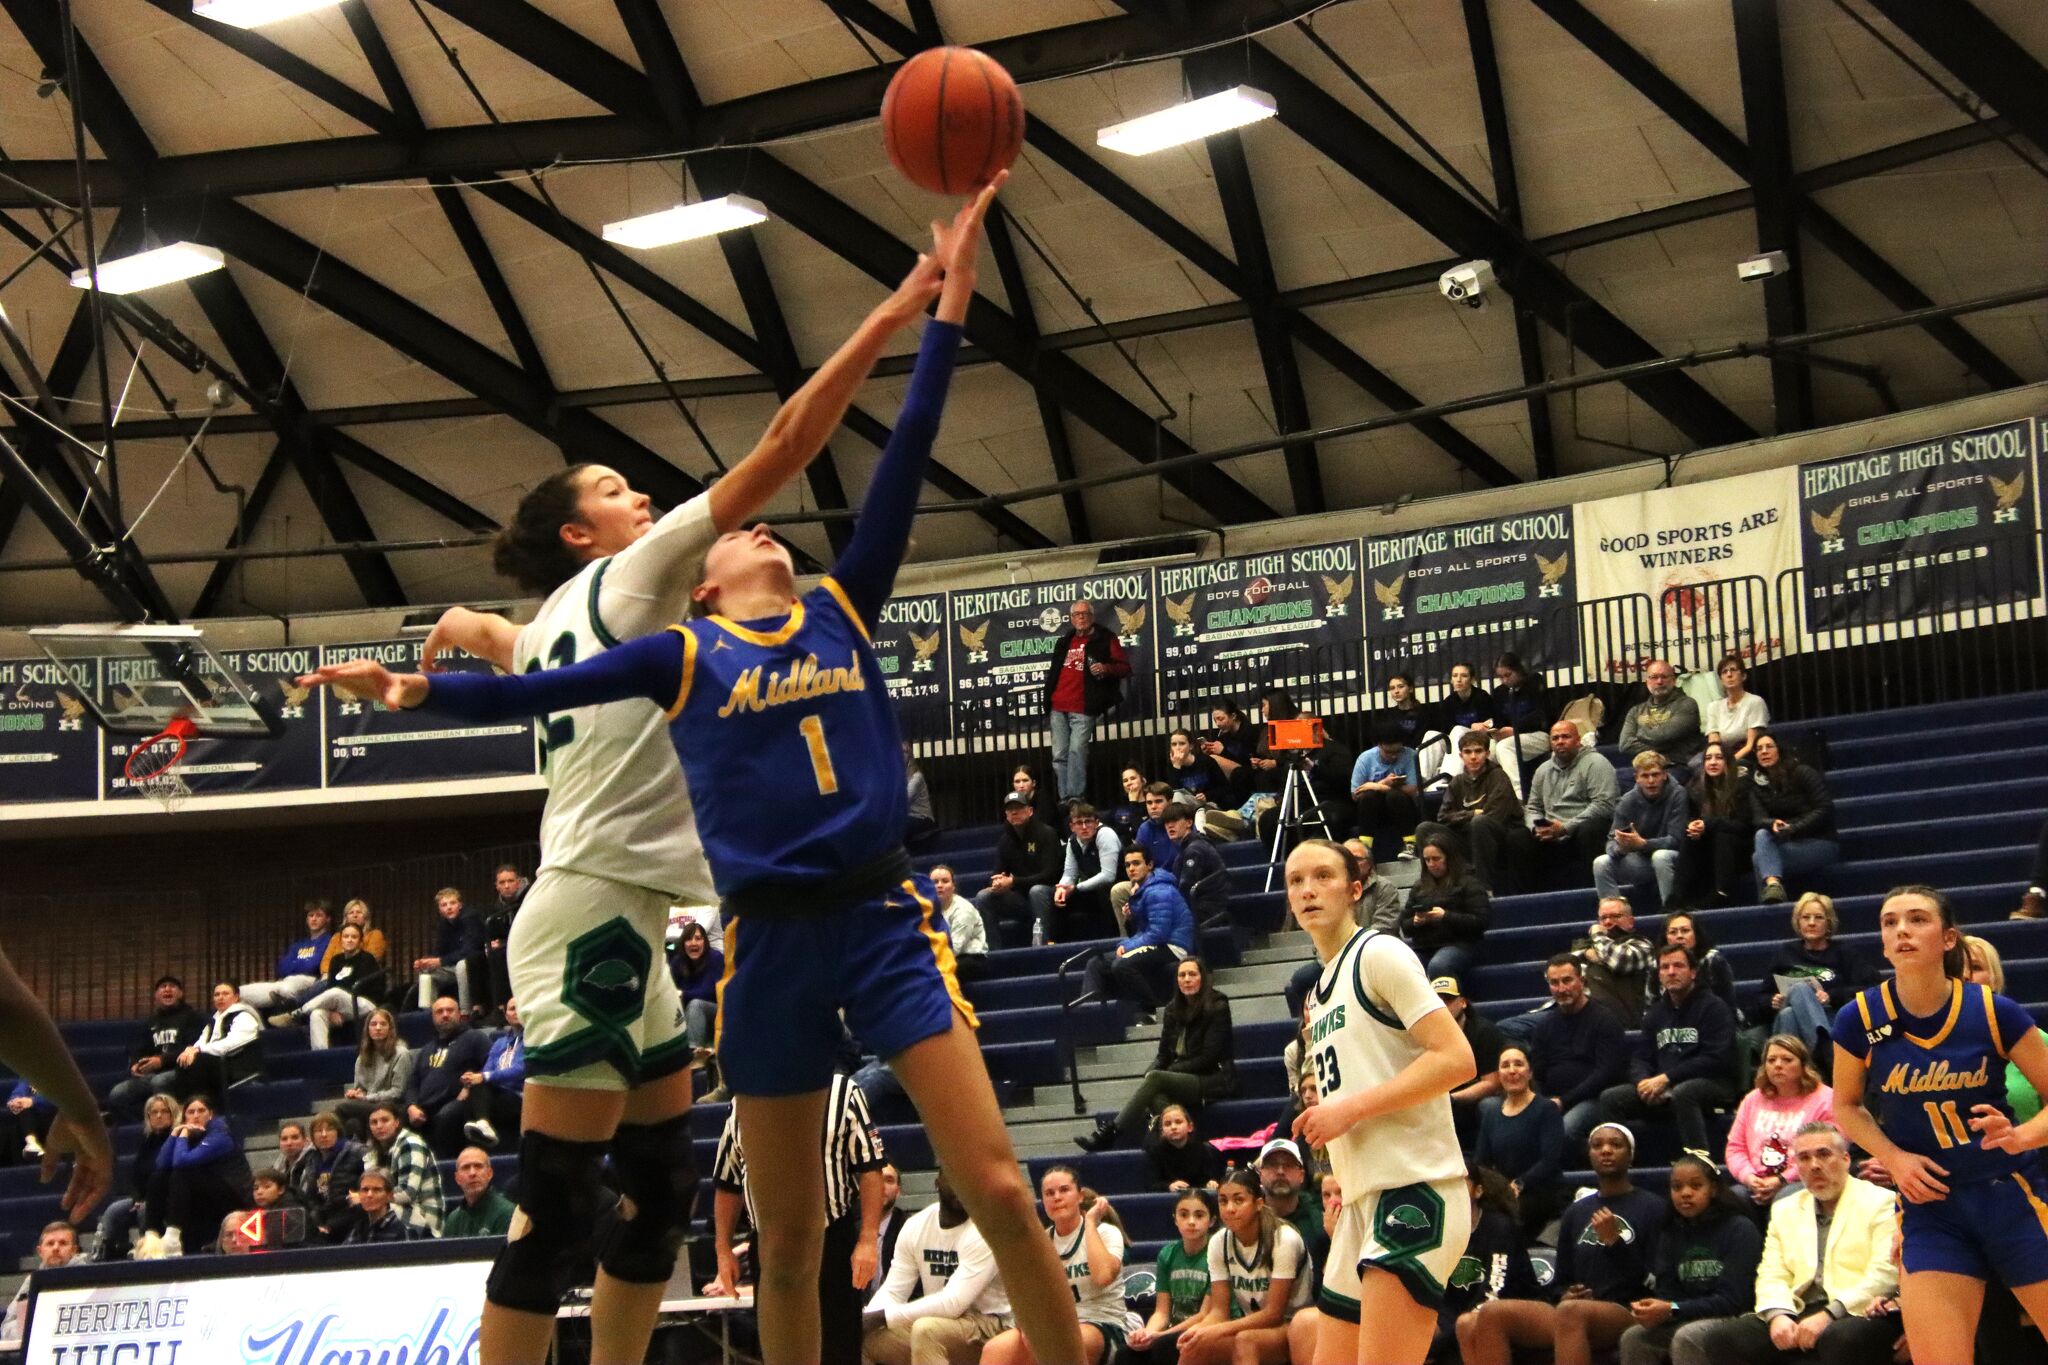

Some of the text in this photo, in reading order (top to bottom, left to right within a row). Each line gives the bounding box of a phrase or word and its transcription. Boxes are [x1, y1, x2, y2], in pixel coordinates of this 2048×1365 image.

[1804, 454, 1892, 499] HERITAGE
[1899, 444, 1945, 473] HIGH
[1952, 428, 2027, 463] SCHOOL
[1848, 474, 1984, 508] GIRLS ALL SPORTS
[1368, 513, 1570, 569] HERITAGE HIGH SCHOOL
[1600, 507, 1779, 553] GOOD SPORTS ARE
[1857, 505, 1978, 546] CHAMPIONS
[1160, 545, 1357, 597] HERITAGE HIGH SCHOOL
[1408, 553, 1528, 578] BOYS ALL SPORTS
[1639, 543, 1734, 569] WINNERS
[954, 575, 1147, 621] HERITAGE HIGH SCHOOL
[1207, 580, 1310, 601] BOYS FOOTBALL
[1416, 581, 1526, 615] CHAMPIONS
[879, 599, 942, 624] SCHOOL
[1008, 614, 1070, 629] BOYS SOC
[1207, 599, 1313, 630] CHAMPIONS
[1205, 620, 1317, 641] SAGINAW VALLEY LEAGUE
[22, 663, 92, 689] SCHOOL
[108, 660, 161, 686] HERIT
[247, 650, 314, 674] SCHOOL
[718, 650, 866, 719] Midland
[8, 700, 55, 710] DIVING
[189, 764, 236, 773] REGIONAL
[799, 714, 839, 796] 1
[1311, 1004, 1346, 1046] AWKS
[1881, 1055, 1989, 1095] Midland
[1922, 1100, 1972, 1150] 11
[53, 1298, 190, 1336] HERITAGE
